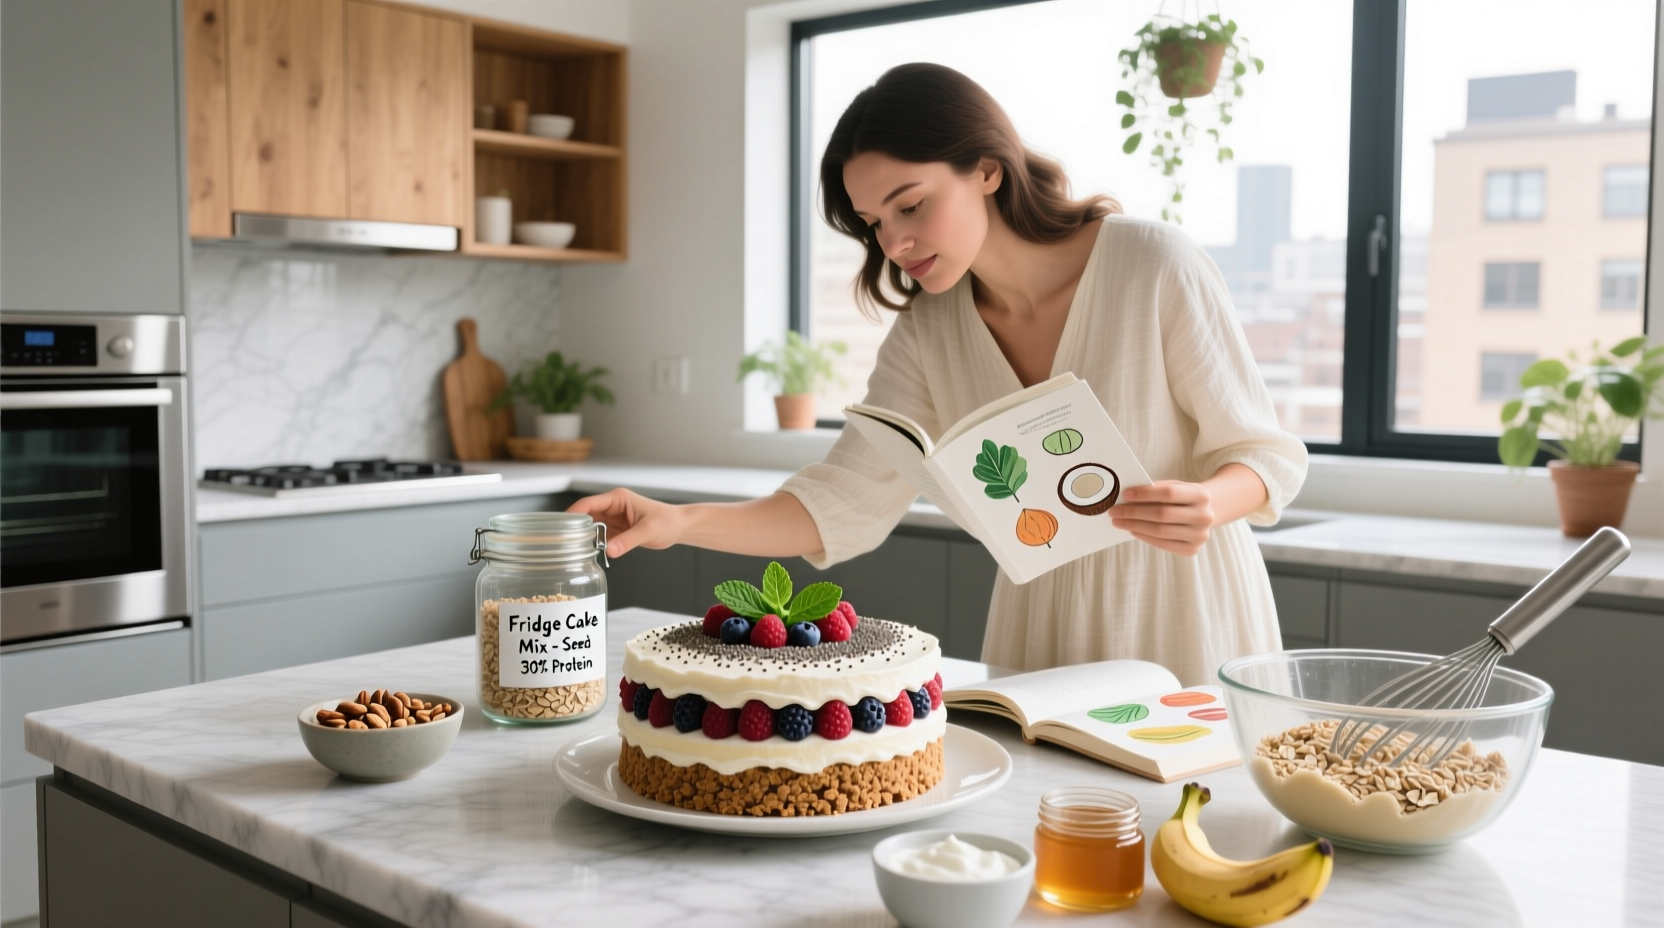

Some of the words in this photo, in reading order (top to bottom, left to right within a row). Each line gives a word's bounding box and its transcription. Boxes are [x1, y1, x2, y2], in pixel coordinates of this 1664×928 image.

[509, 615, 561, 637] Fridge
[566, 611, 598, 629] Cake
[519, 639, 548, 654] Mix
[562, 635, 591, 651] Seed
[521, 659, 548, 674] 30%
[552, 656, 593, 673] Protein
